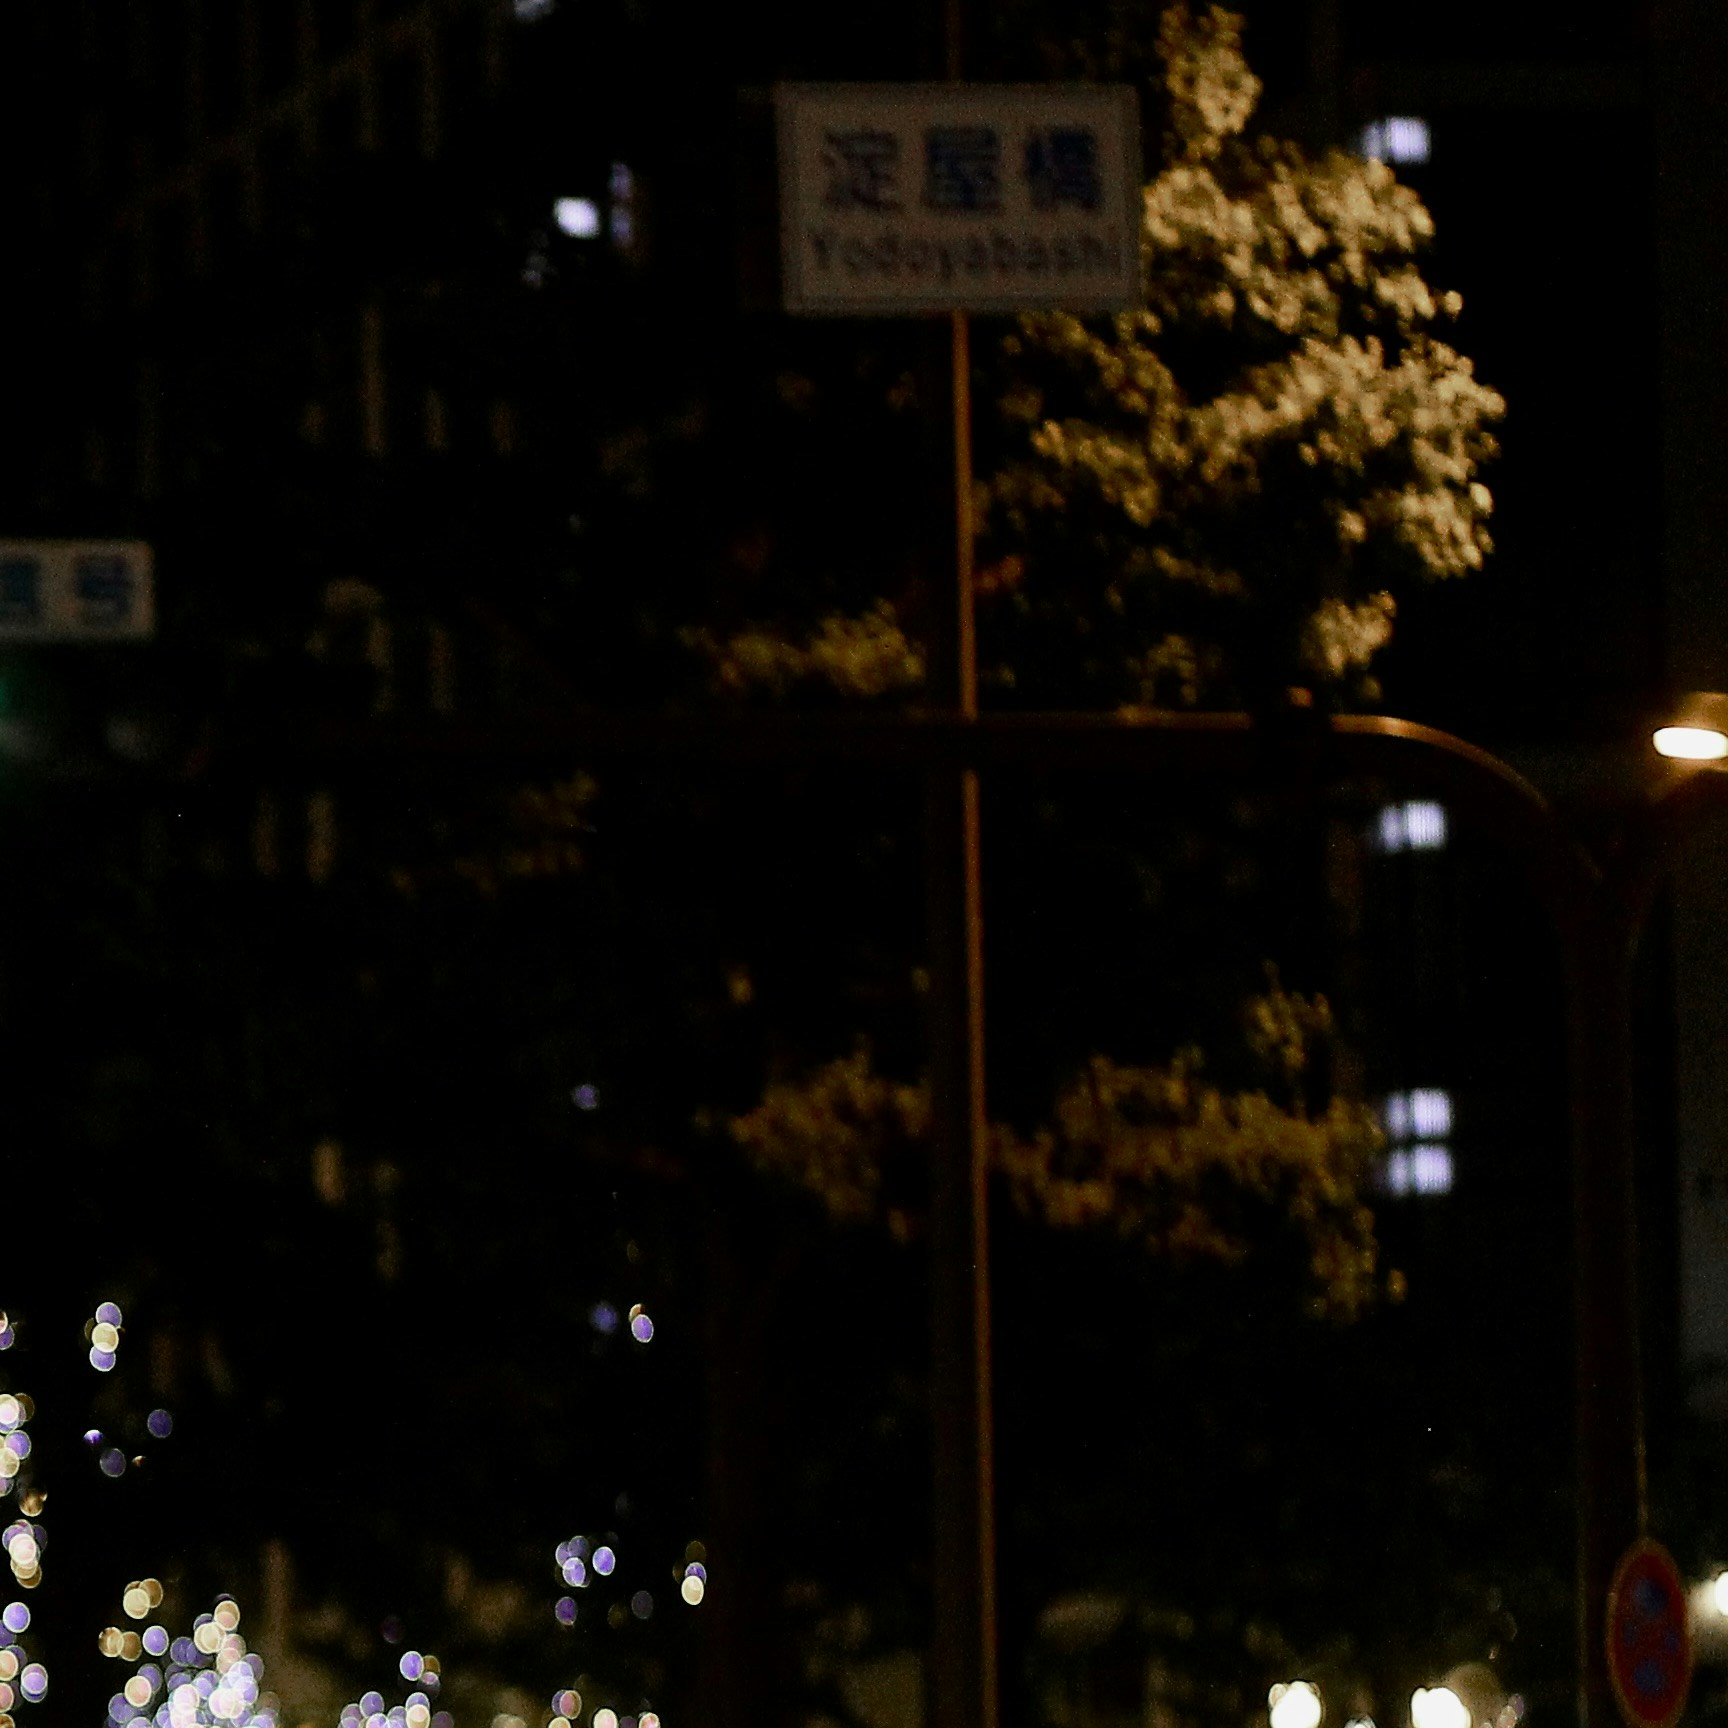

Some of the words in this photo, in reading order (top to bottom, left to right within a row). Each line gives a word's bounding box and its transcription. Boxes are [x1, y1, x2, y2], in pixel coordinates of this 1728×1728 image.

[822, 125, 1102, 212] 淀屋橋
[810, 226, 1120, 282] Yodoyabashi
